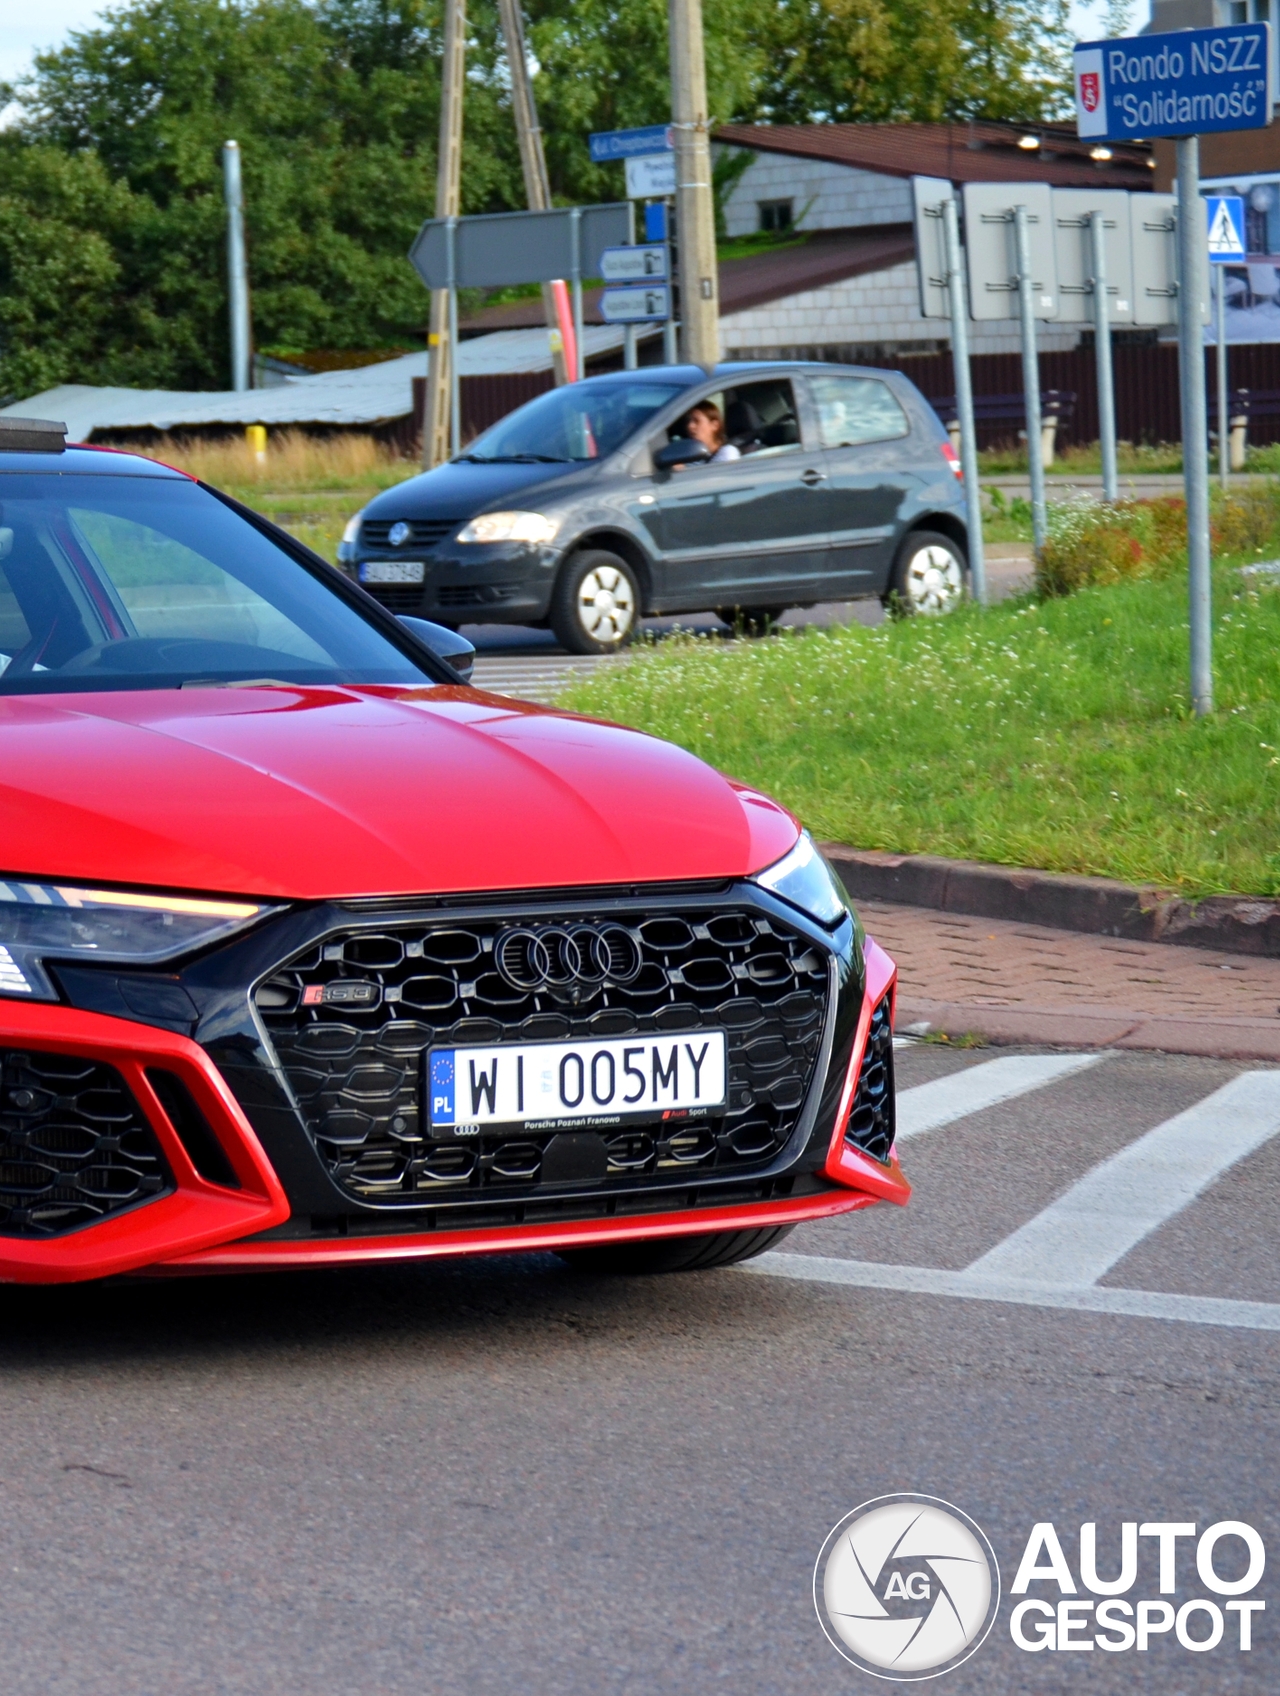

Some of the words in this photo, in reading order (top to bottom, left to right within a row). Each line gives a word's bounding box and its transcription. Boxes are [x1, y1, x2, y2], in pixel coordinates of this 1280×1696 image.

[1108, 44, 1184, 85] Rondo
[1191, 34, 1261, 76] NSZZ
[315, 988, 348, 1000] RS
[354, 987, 369, 999] 3
[433, 1096, 452, 1114] PL
[671, 1109, 688, 1117] Audi
[689, 1108, 707, 1116] Sport
[524, 1121, 556, 1130] Porsche
[557, 1118, 586, 1127] Poznań
[587, 1116, 620, 1125] Franowo
